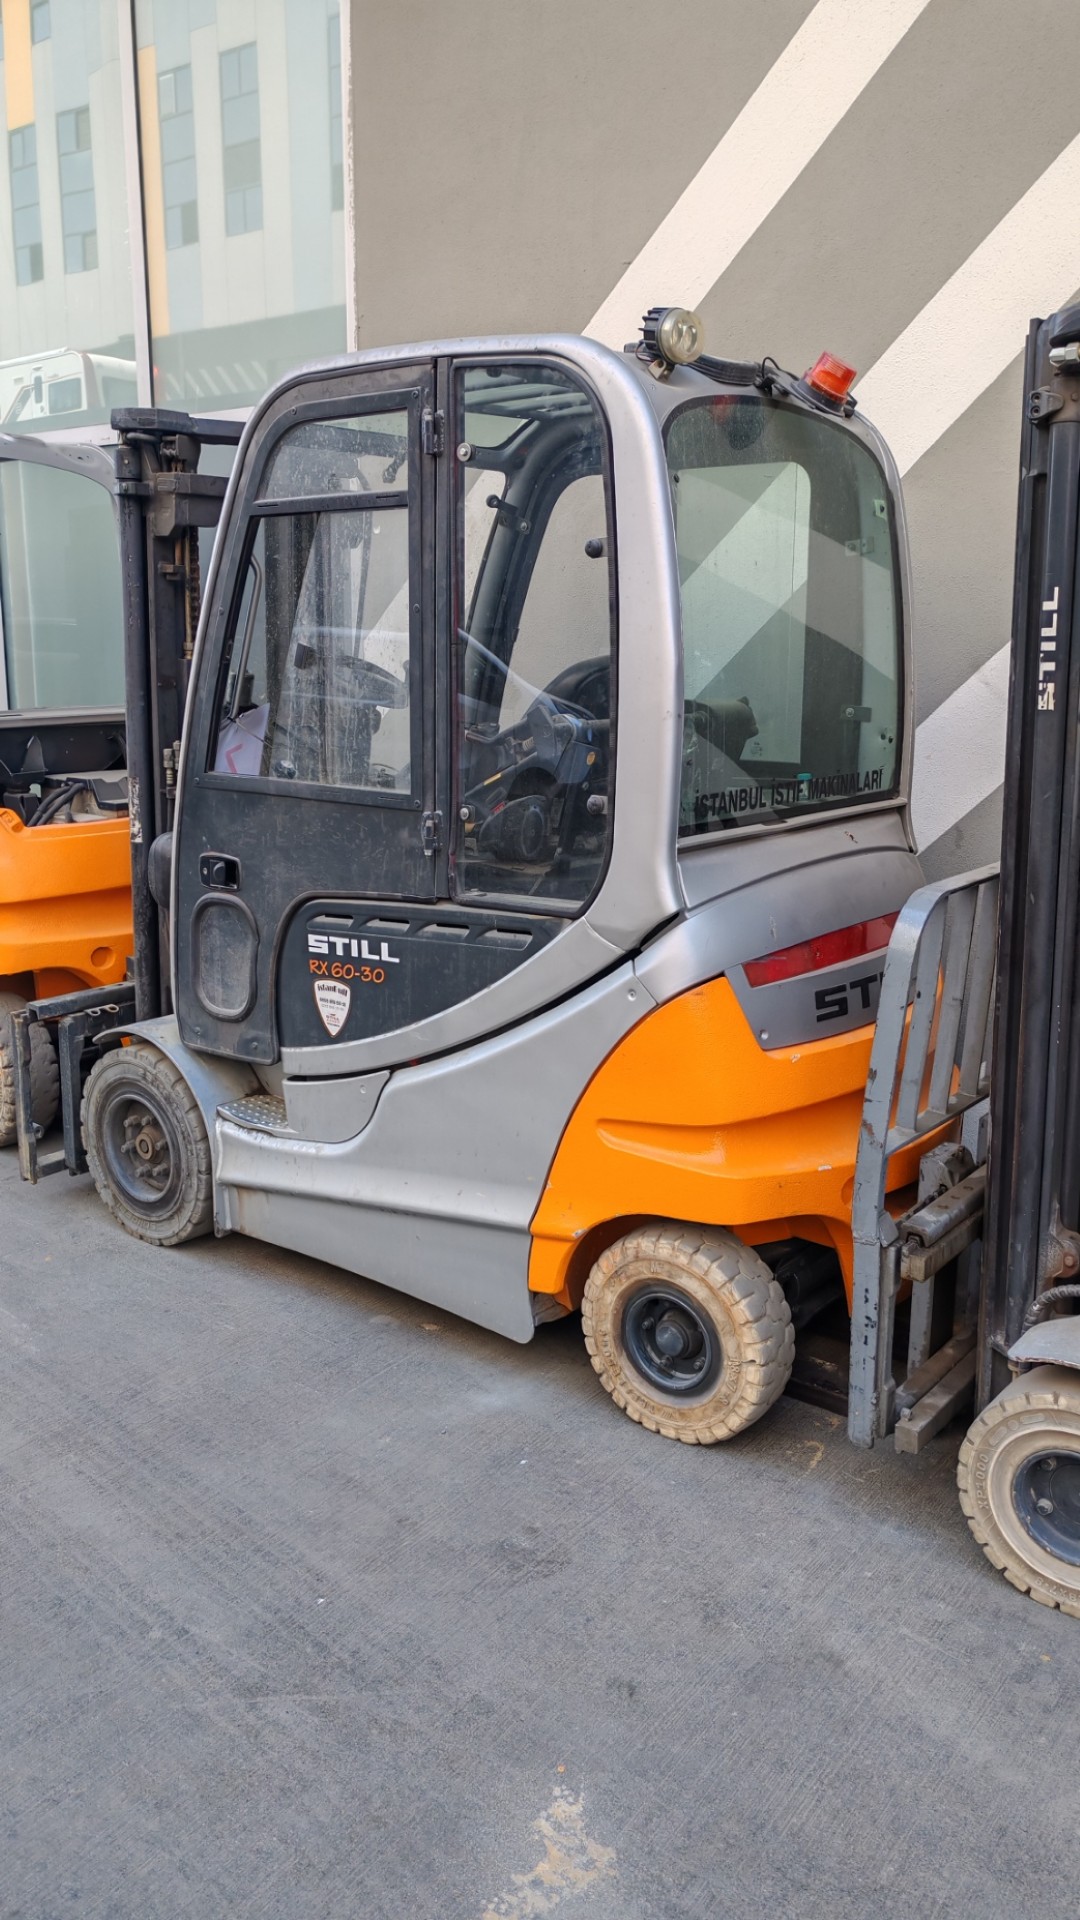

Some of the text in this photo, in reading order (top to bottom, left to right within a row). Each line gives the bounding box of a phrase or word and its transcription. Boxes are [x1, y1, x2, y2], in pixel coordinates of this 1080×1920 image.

[1038, 586, 1059, 711] STILL
[308, 934, 400, 963] STILL
[309, 959, 385, 984] RX 60-30
[815, 971, 886, 1023] ST
